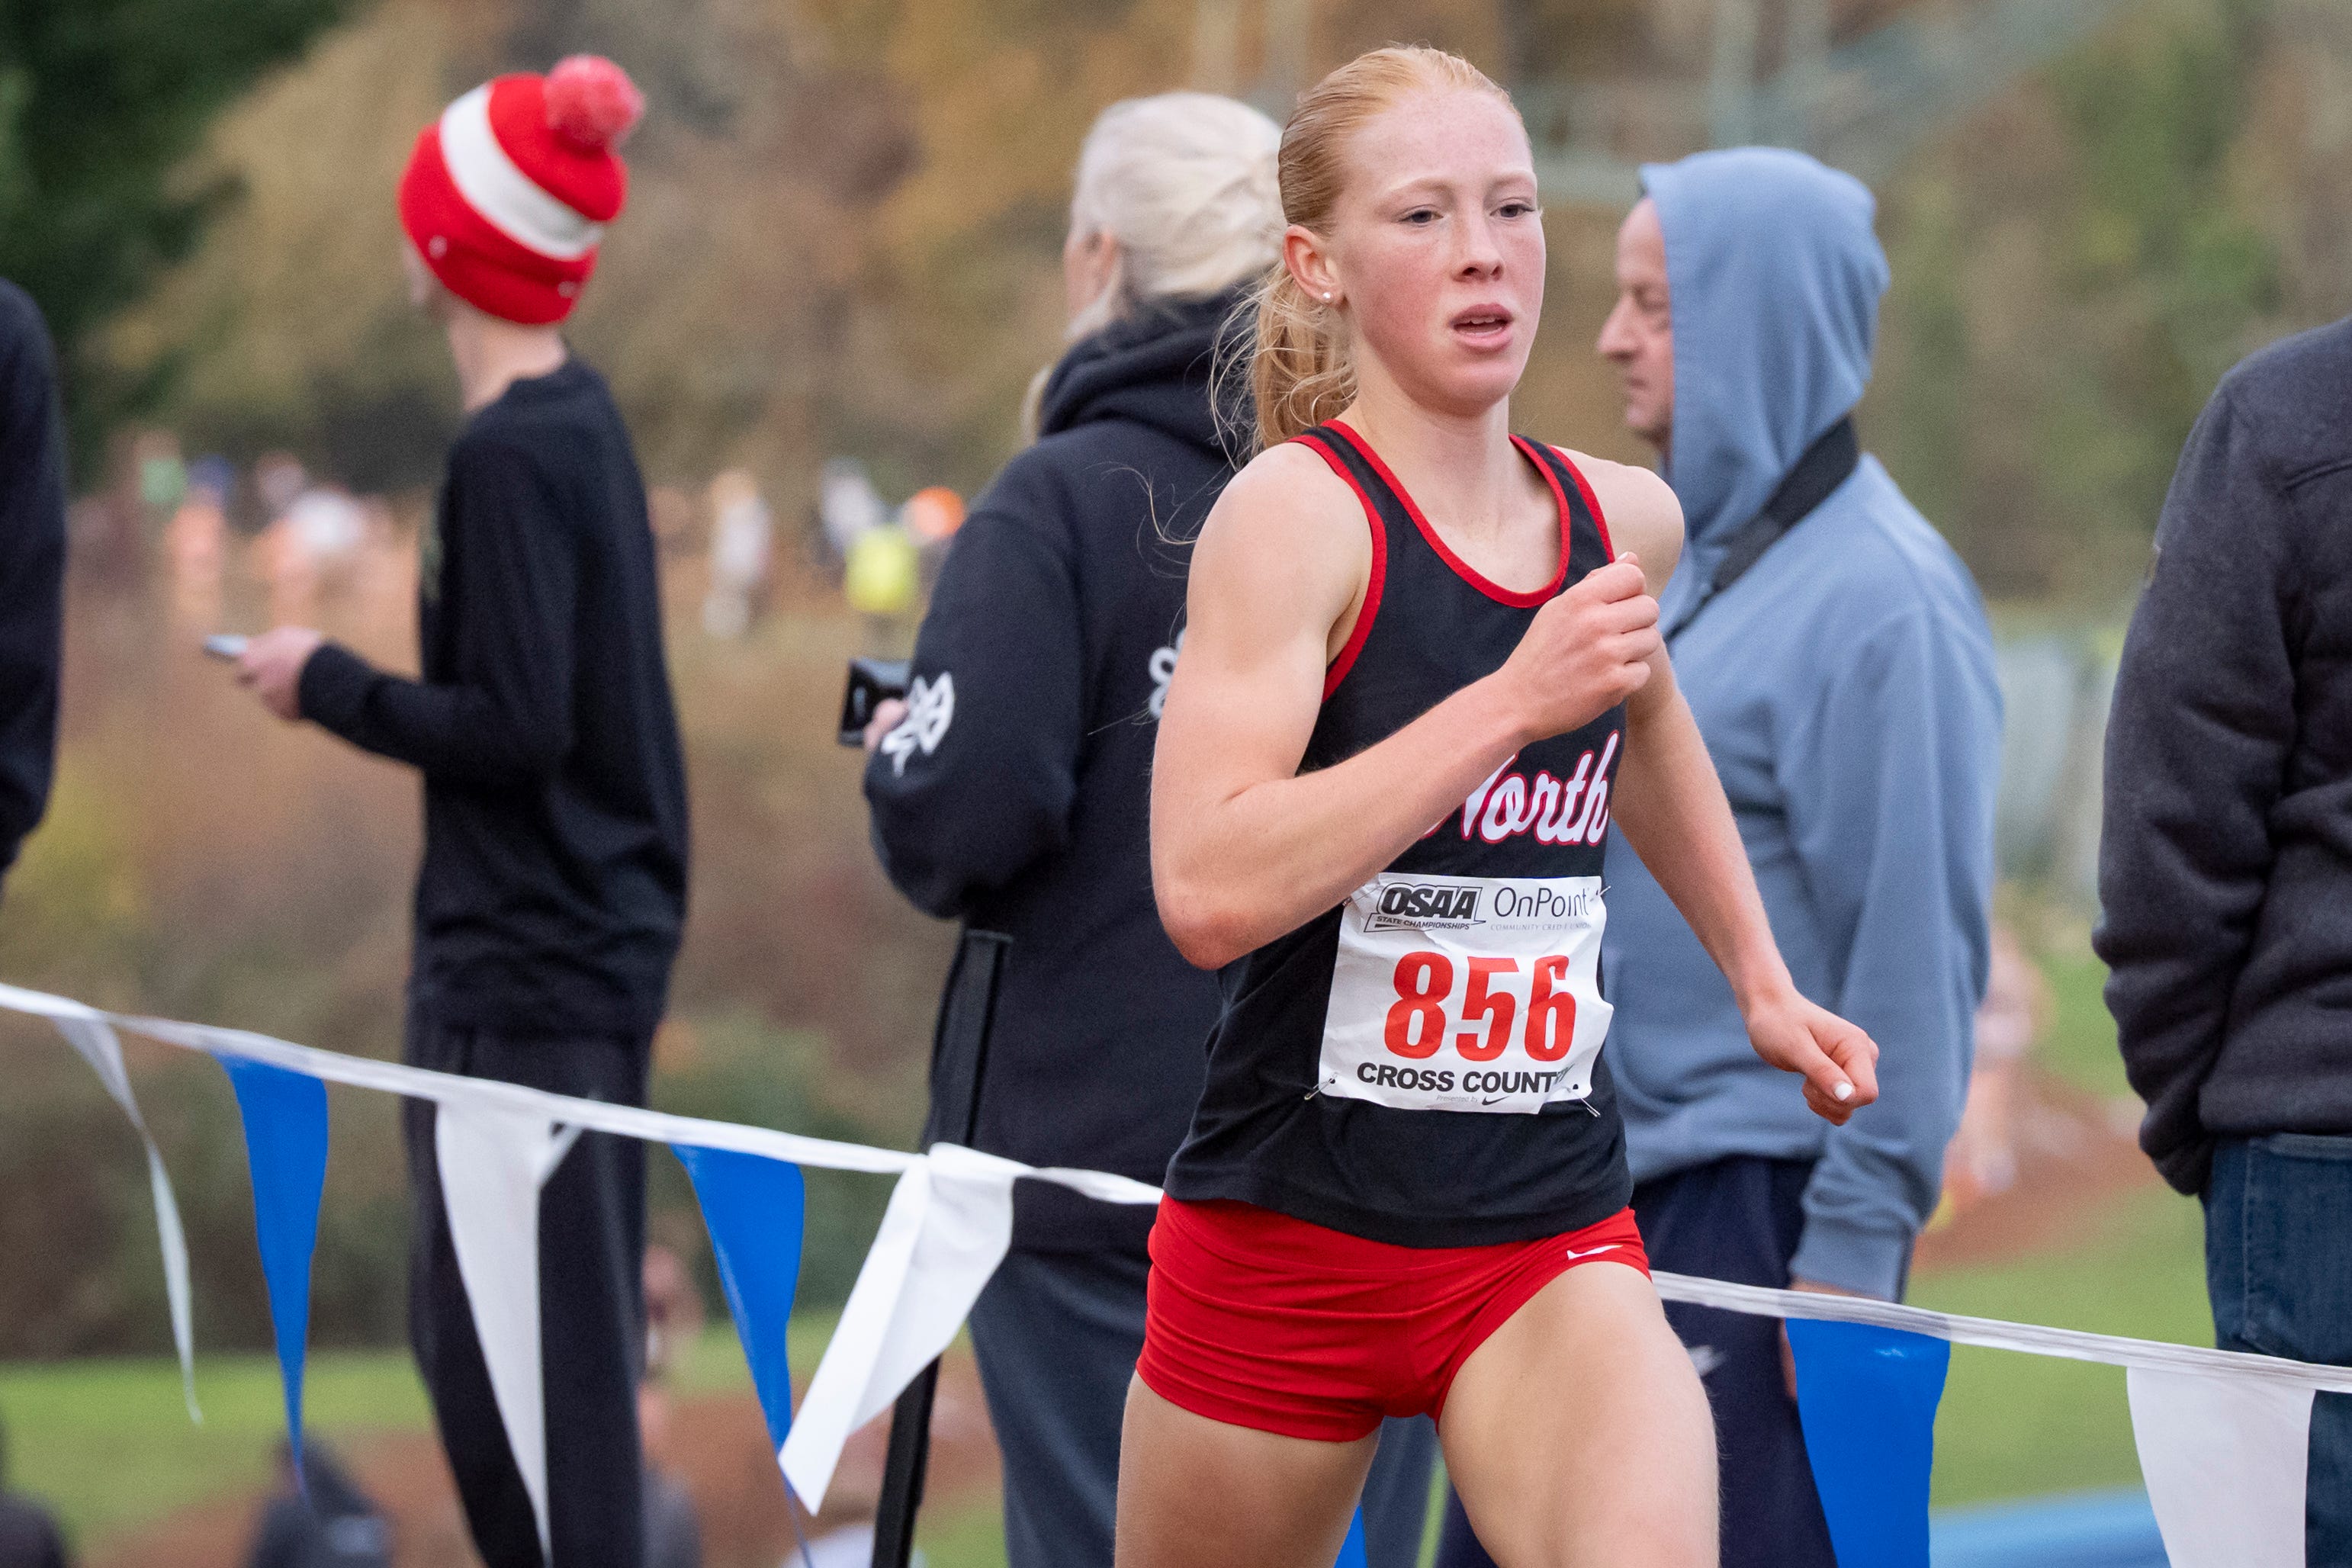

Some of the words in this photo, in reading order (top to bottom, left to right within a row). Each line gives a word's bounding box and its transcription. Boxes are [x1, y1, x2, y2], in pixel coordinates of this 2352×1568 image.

[1380, 887, 1478, 920] OSAA
[1494, 886, 1589, 917] OnPoint
[1376, 915, 1403, 925] STATE
[1403, 920, 1470, 930] CHAMPIONSHIPS
[1490, 923, 1539, 931] COMMUNITY
[1542, 923, 1568, 931] CREDT
[1383, 950, 1577, 1062] 856
[1356, 1062, 1455, 1092] CROSS
[1462, 1067, 1571, 1093] COUNT
